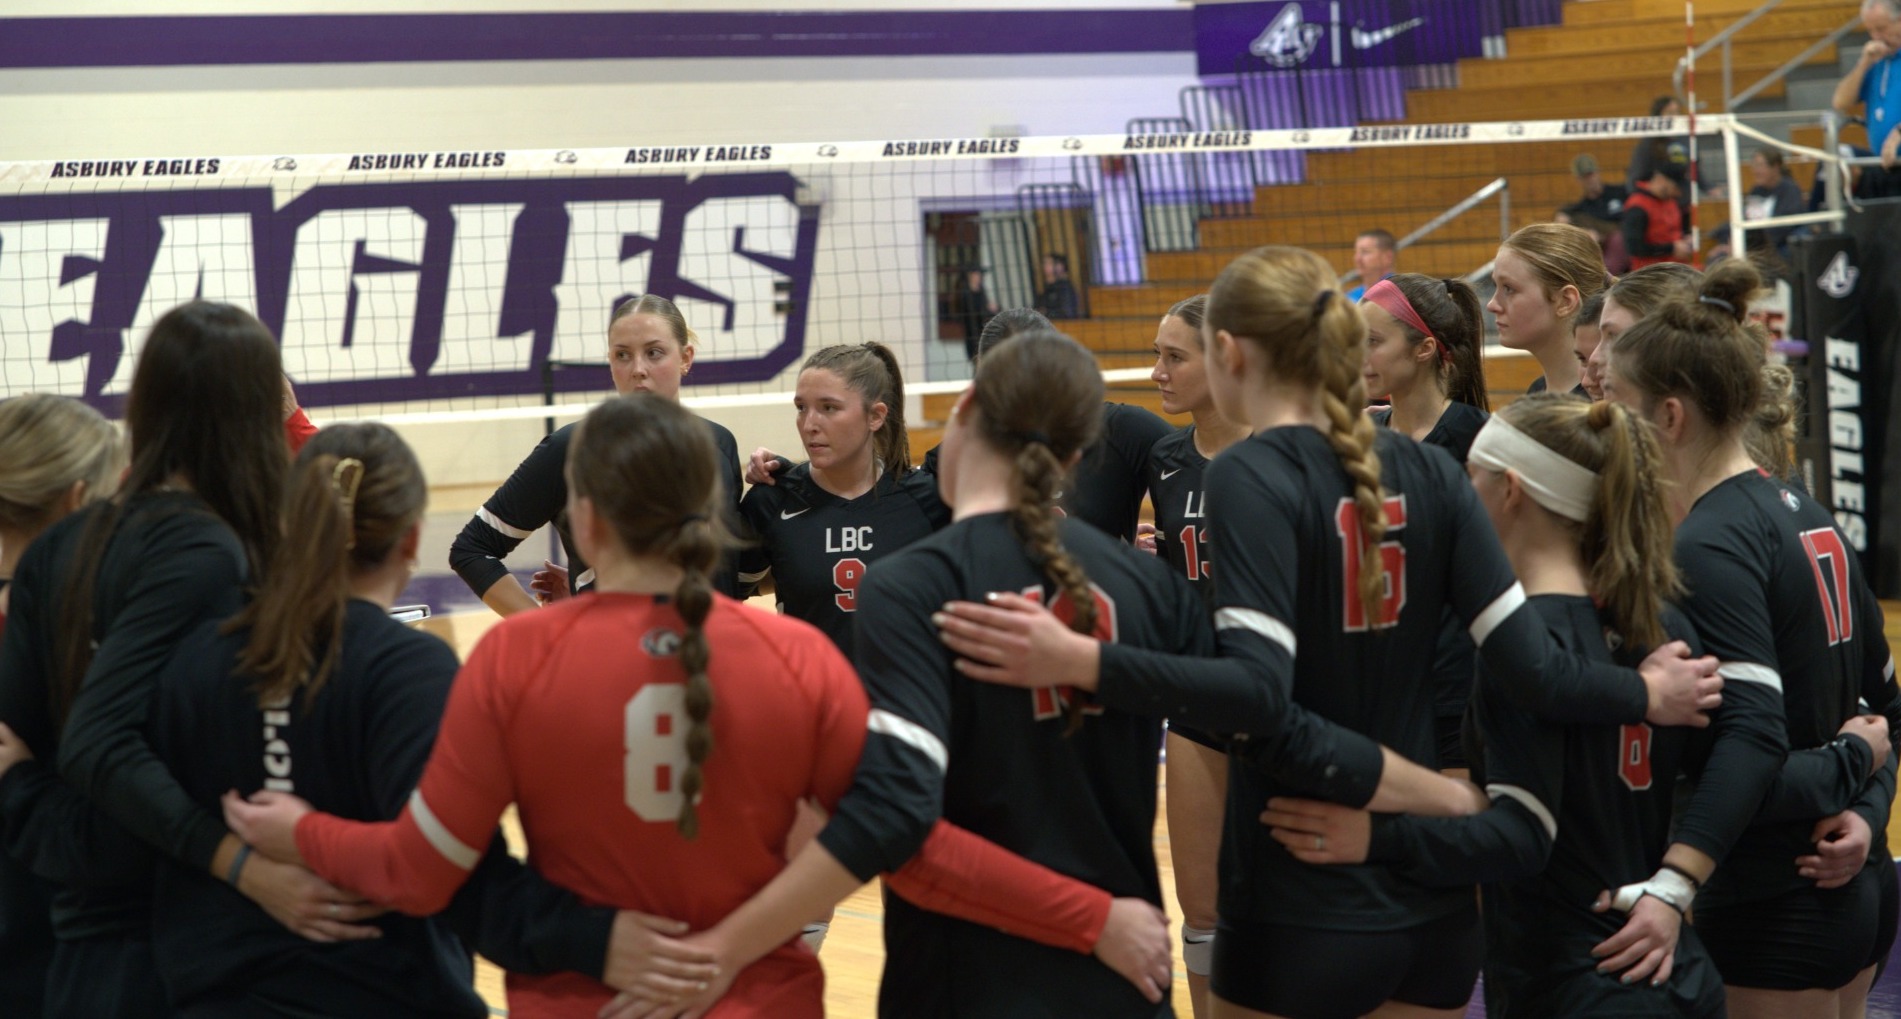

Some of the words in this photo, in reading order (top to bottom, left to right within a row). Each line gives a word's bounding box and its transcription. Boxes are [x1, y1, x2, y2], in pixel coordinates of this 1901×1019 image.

[1349, 126, 1410, 143] ASBURY
[1414, 124, 1471, 141] EAGLES
[1563, 121, 1618, 134] ASBURY
[1622, 119, 1673, 131] EAGLES
[883, 140, 952, 157] ASBURY
[957, 139, 1020, 155] EAGLES
[1123, 134, 1189, 150] ASBURY
[1193, 131, 1253, 148] EAGLES
[348, 153, 428, 171] ASBURY
[433, 151, 506, 169] EAGLES
[624, 147, 699, 164] ASBURY
[705, 145, 772, 162] EAGLES
[50, 160, 137, 178] ASBURY
[143, 158, 220, 177] EAGLES
[0, 196, 798, 398] EAGLES
[1825, 336, 1867, 551] EAGLES
[825, 526, 873, 553] LBC
[833, 558, 867, 612] 9
[1799, 526, 1853, 647] 17
[624, 683, 703, 823] 8
